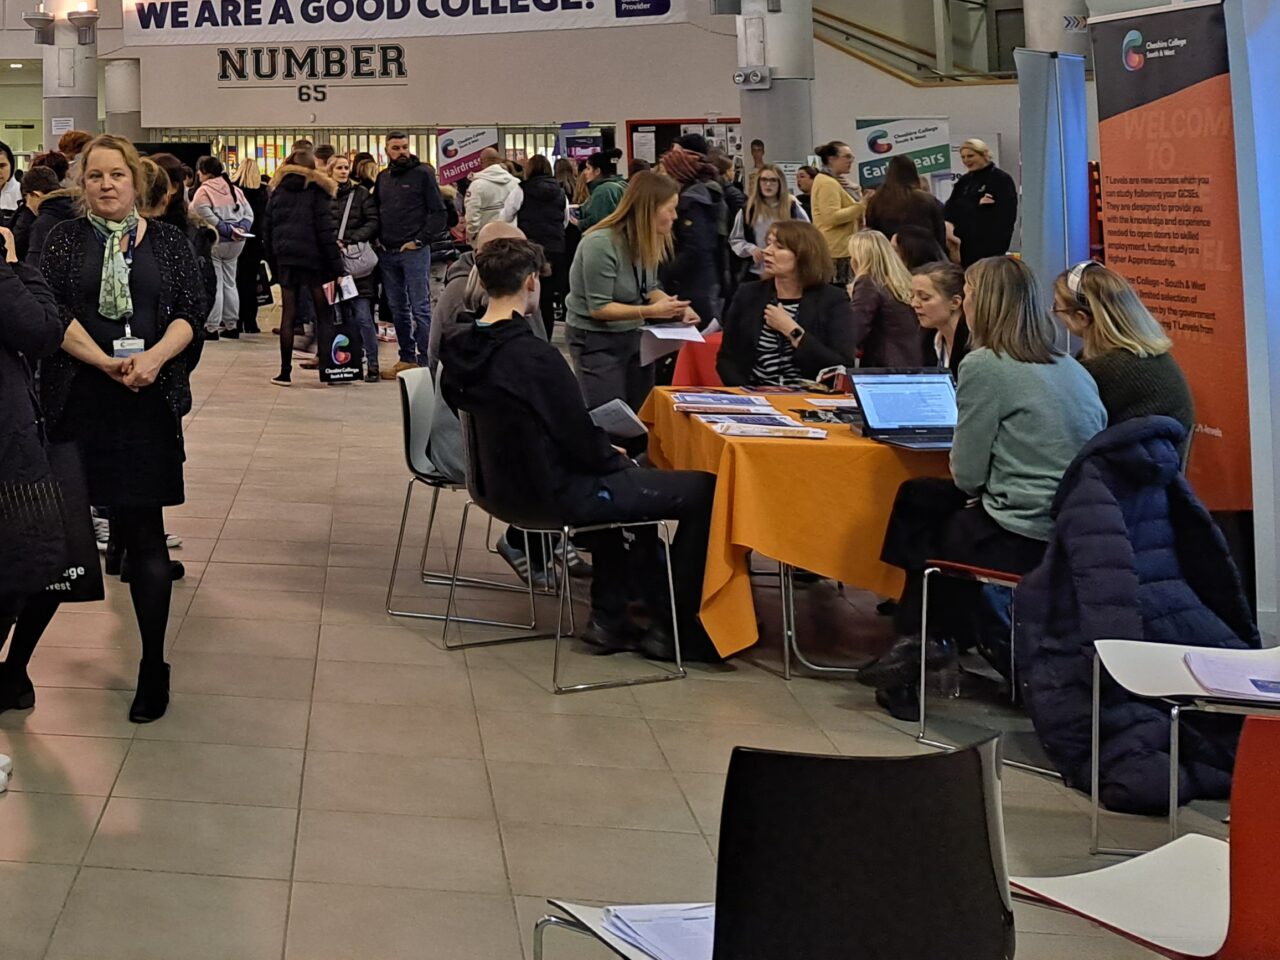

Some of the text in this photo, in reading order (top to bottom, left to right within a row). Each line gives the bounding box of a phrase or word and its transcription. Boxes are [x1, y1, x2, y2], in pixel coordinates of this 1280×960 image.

[135, 1, 189, 30] WE
[621, 2, 651, 11] Provider
[217, 43, 408, 81] NUMBER
[297, 85, 327, 102] 65
